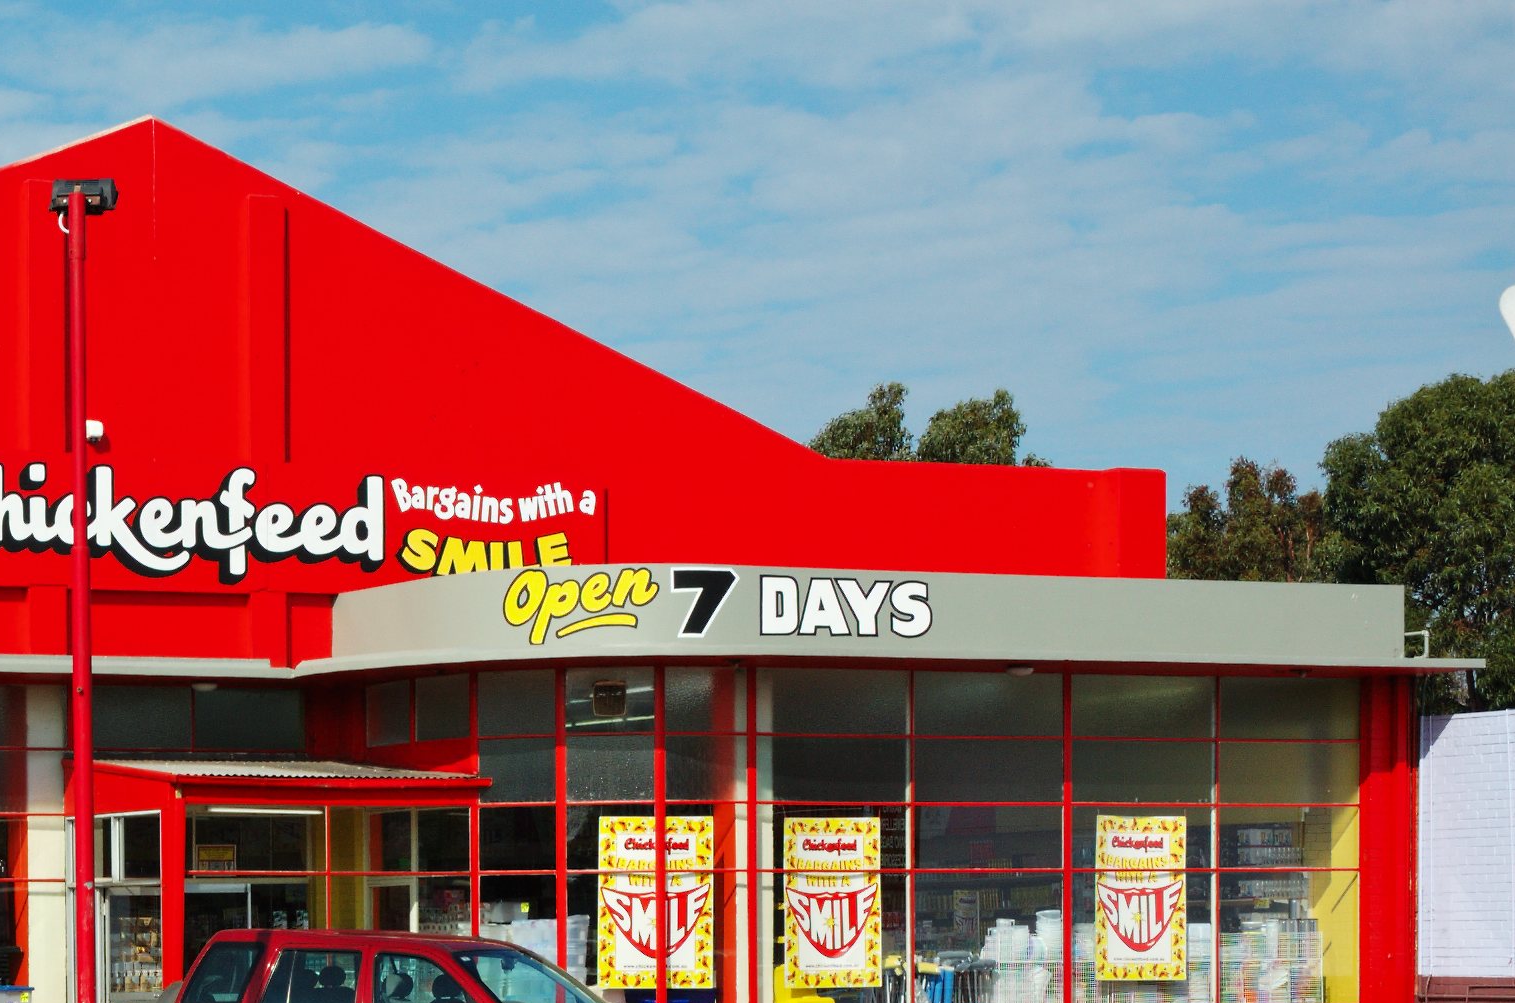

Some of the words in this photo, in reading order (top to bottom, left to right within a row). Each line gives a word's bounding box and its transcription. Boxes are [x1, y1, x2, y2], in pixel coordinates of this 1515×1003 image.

[391, 478, 514, 524] Bargains
[518, 482, 574, 522] with
[579, 489, 596, 516] a
[396, 528, 572, 577] SMILE
[503, 567, 660, 646] Open
[670, 567, 740, 638] 7
[759, 574, 933, 638] DAYS
[802, 838, 857, 855] Chickenfeed
[1111, 836, 1164, 853] Chickenfeed
[797, 858, 862, 870] BARGAINS
[1106, 855, 1168, 868] BARGAINS
[670, 875, 682, 887] A
[806, 875, 836, 887] WITH
[841, 875, 851, 887] A
[1115, 872, 1144, 883] WITH
[786, 883, 878, 950] SMILE
[1097, 880, 1184, 944] SMILE
